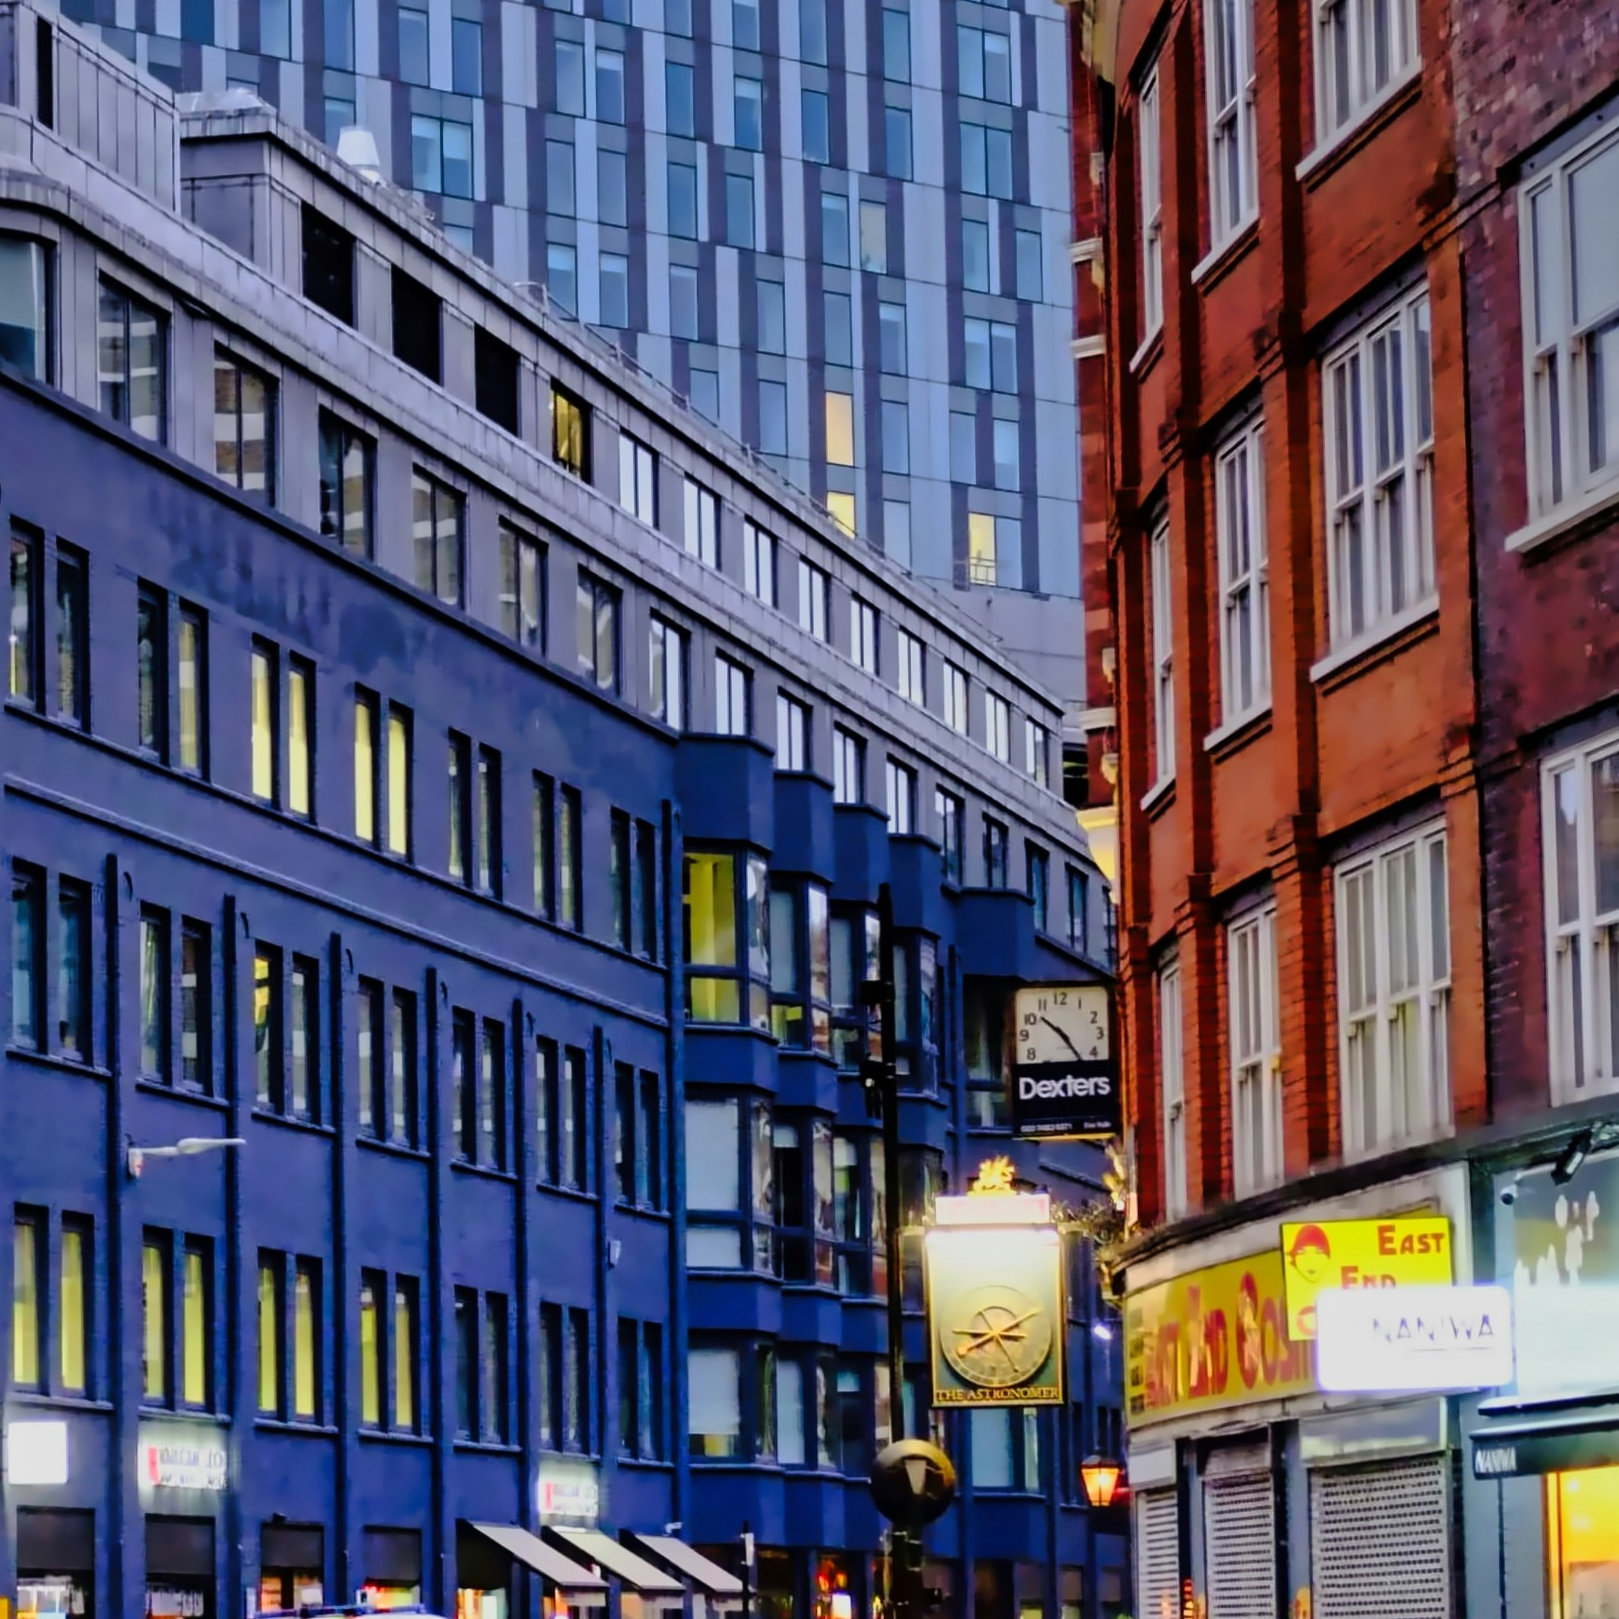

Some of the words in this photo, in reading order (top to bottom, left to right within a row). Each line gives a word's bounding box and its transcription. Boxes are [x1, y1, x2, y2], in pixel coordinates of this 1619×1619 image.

[1037, 998, 1048, 1012] 11
[1053, 991, 1068, 1006] 12
[1024, 1012, 1037, 1026] 10
[1089, 1010, 1099, 1025] 2
[1019, 1029, 1030, 1042] 9
[1095, 1026, 1105, 1041] 3
[1026, 1047, 1037, 1061] 8
[1089, 1045, 1099, 1059] 4
[1018, 1074, 1112, 1100] Dexters
[1376, 1224, 1446, 1256] EAST
[935, 1389, 965, 1401] THE
[967, 1387, 1060, 1400] ASTRONOMER
